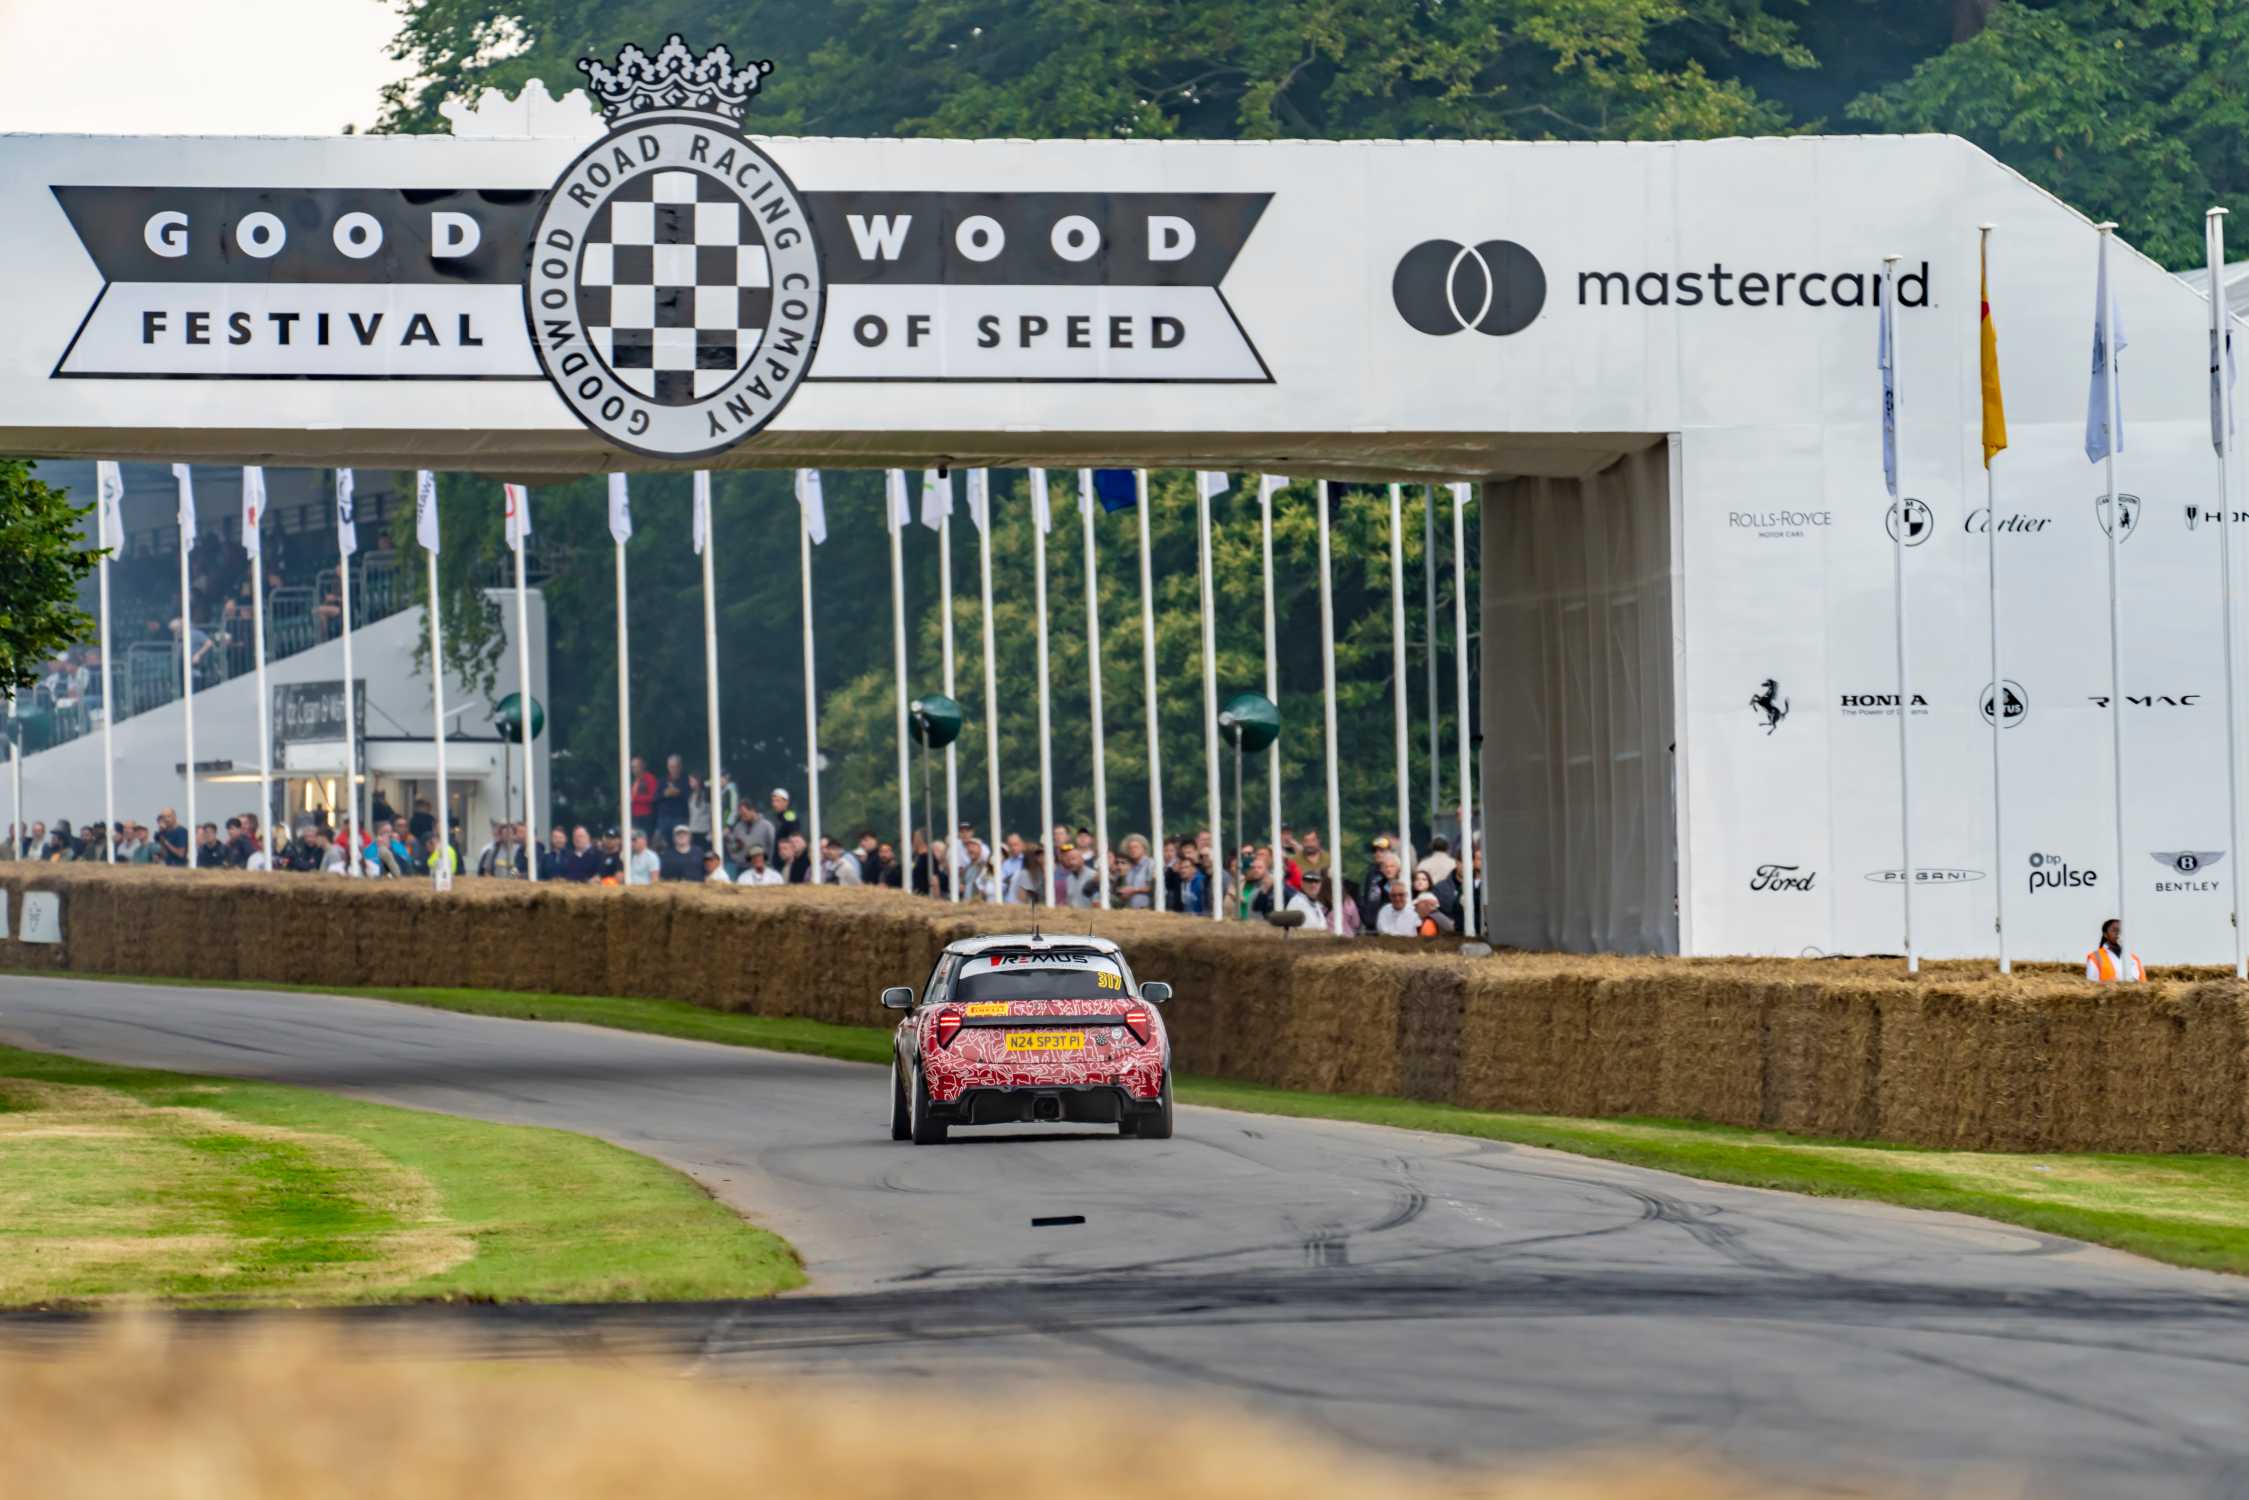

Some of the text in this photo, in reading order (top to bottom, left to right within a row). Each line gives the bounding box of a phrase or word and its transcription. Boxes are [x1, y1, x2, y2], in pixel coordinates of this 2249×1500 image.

[143, 210, 1197, 263] GOOD WOOD
[541, 133, 809, 438] GOODWOOD ROAD RACING COMPANY
[1578, 261, 1929, 308] mastercard
[142, 310, 1186, 350] FESTIVAL OF SPEED
[1728, 510, 1832, 528] ROLLS-ROYCE
[1987, 704, 2022, 714] LTUS
[2088, 695, 2201, 708] RMAC
[2046, 854, 2061, 866] bp
[1749, 864, 1816, 892] Ford
[2029, 863, 2097, 895] pulse
[2155, 881, 2220, 892] BENTLEY
[1002, 953, 1089, 965] REMUS
[1097, 971, 1122, 991] 317
[1010, 1036, 1033, 1048] N24
